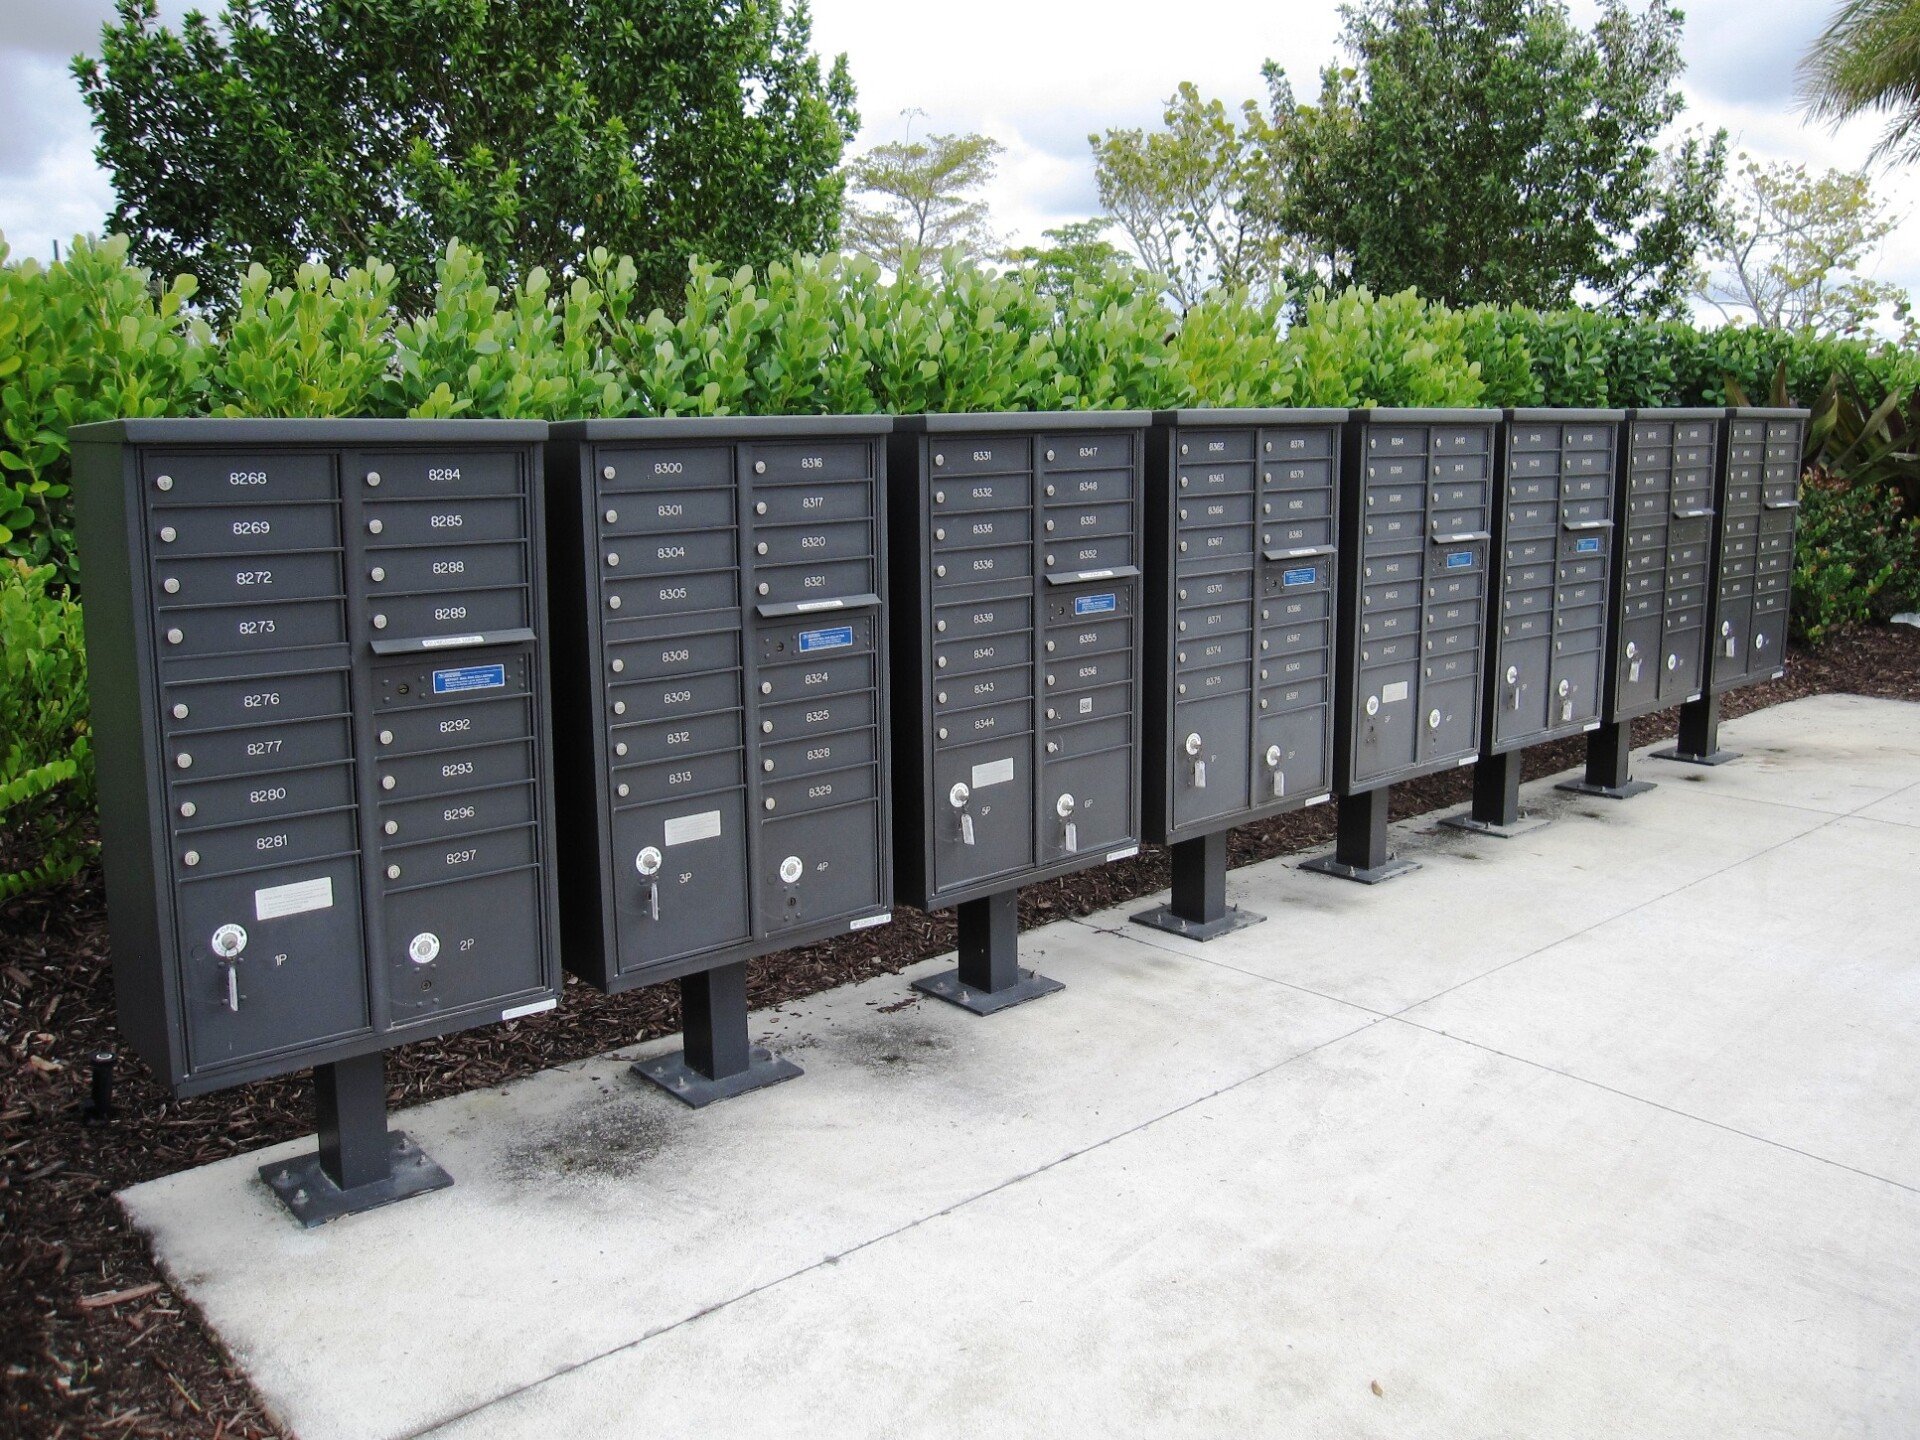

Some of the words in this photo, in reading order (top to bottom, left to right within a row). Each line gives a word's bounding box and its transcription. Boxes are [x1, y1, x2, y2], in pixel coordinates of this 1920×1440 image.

[1289, 439, 1305, 449] 8378
[973, 450, 992, 462] 8331
[1079, 447, 1098, 457] 8347
[655, 463, 682, 474] 8300
[801, 457, 823, 469] 8316
[230, 472, 266, 485] 8268
[429, 469, 460, 480] 8284
[1289, 469, 1305, 479] 8379
[972, 487, 993, 498] 8332
[1079, 481, 1098, 492] 8348
[802, 496, 824, 509] 8317
[658, 505, 682, 516] 8301
[431, 515, 462, 527] 8285
[1080, 515, 1097, 526] 8351
[233, 521, 269, 534] 8269
[972, 523, 993, 535] 8335
[802, 537, 825, 547] 8320
[1207, 536, 1224, 547] 8367
[658, 547, 684, 558] 8304
[1079, 549, 1098, 560] 8352
[433, 561, 464, 574] 8288
[973, 559, 994, 571] 8336
[237, 571, 272, 585] 8272
[804, 575, 826, 588] 8321
[660, 588, 686, 600] 8305
[1206, 583, 1223, 594] 8370
[435, 607, 466, 620] 8289
[973, 612, 994, 624] 8339
[1207, 614, 1222, 625] 8371
[240, 621, 275, 634] 8273
[1079, 633, 1098, 644] 8355
[662, 650, 688, 662] 8308
[973, 647, 995, 659] 8340
[1205, 645, 1222, 656] 8374
[1079, 666, 1097, 678] 8356
[805, 673, 828, 684] 8324
[1205, 675, 1222, 686] 8375
[973, 682, 995, 694] 8343
[244, 693, 279, 707] 8276
[664, 691, 690, 703] 8309
[806, 710, 829, 722] 8325
[440, 719, 470, 732] 8292
[974, 717, 995, 730] 8344
[667, 731, 690, 745] 8312
[248, 740, 282, 755] 8277
[807, 748, 830, 760] 8328
[443, 763, 473, 776] 8293
[669, 772, 691, 784] 8313
[251, 788, 286, 802] 8280
[809, 785, 831, 797] 8329
[444, 806, 474, 820] 8296
[257, 835, 287, 849] 8281
[447, 850, 476, 864] 8297
[816, 861, 829, 872] 4P
[679, 872, 692, 884] 3P
[459, 938, 475, 952] 2P
[274, 953, 288, 966] 1P
